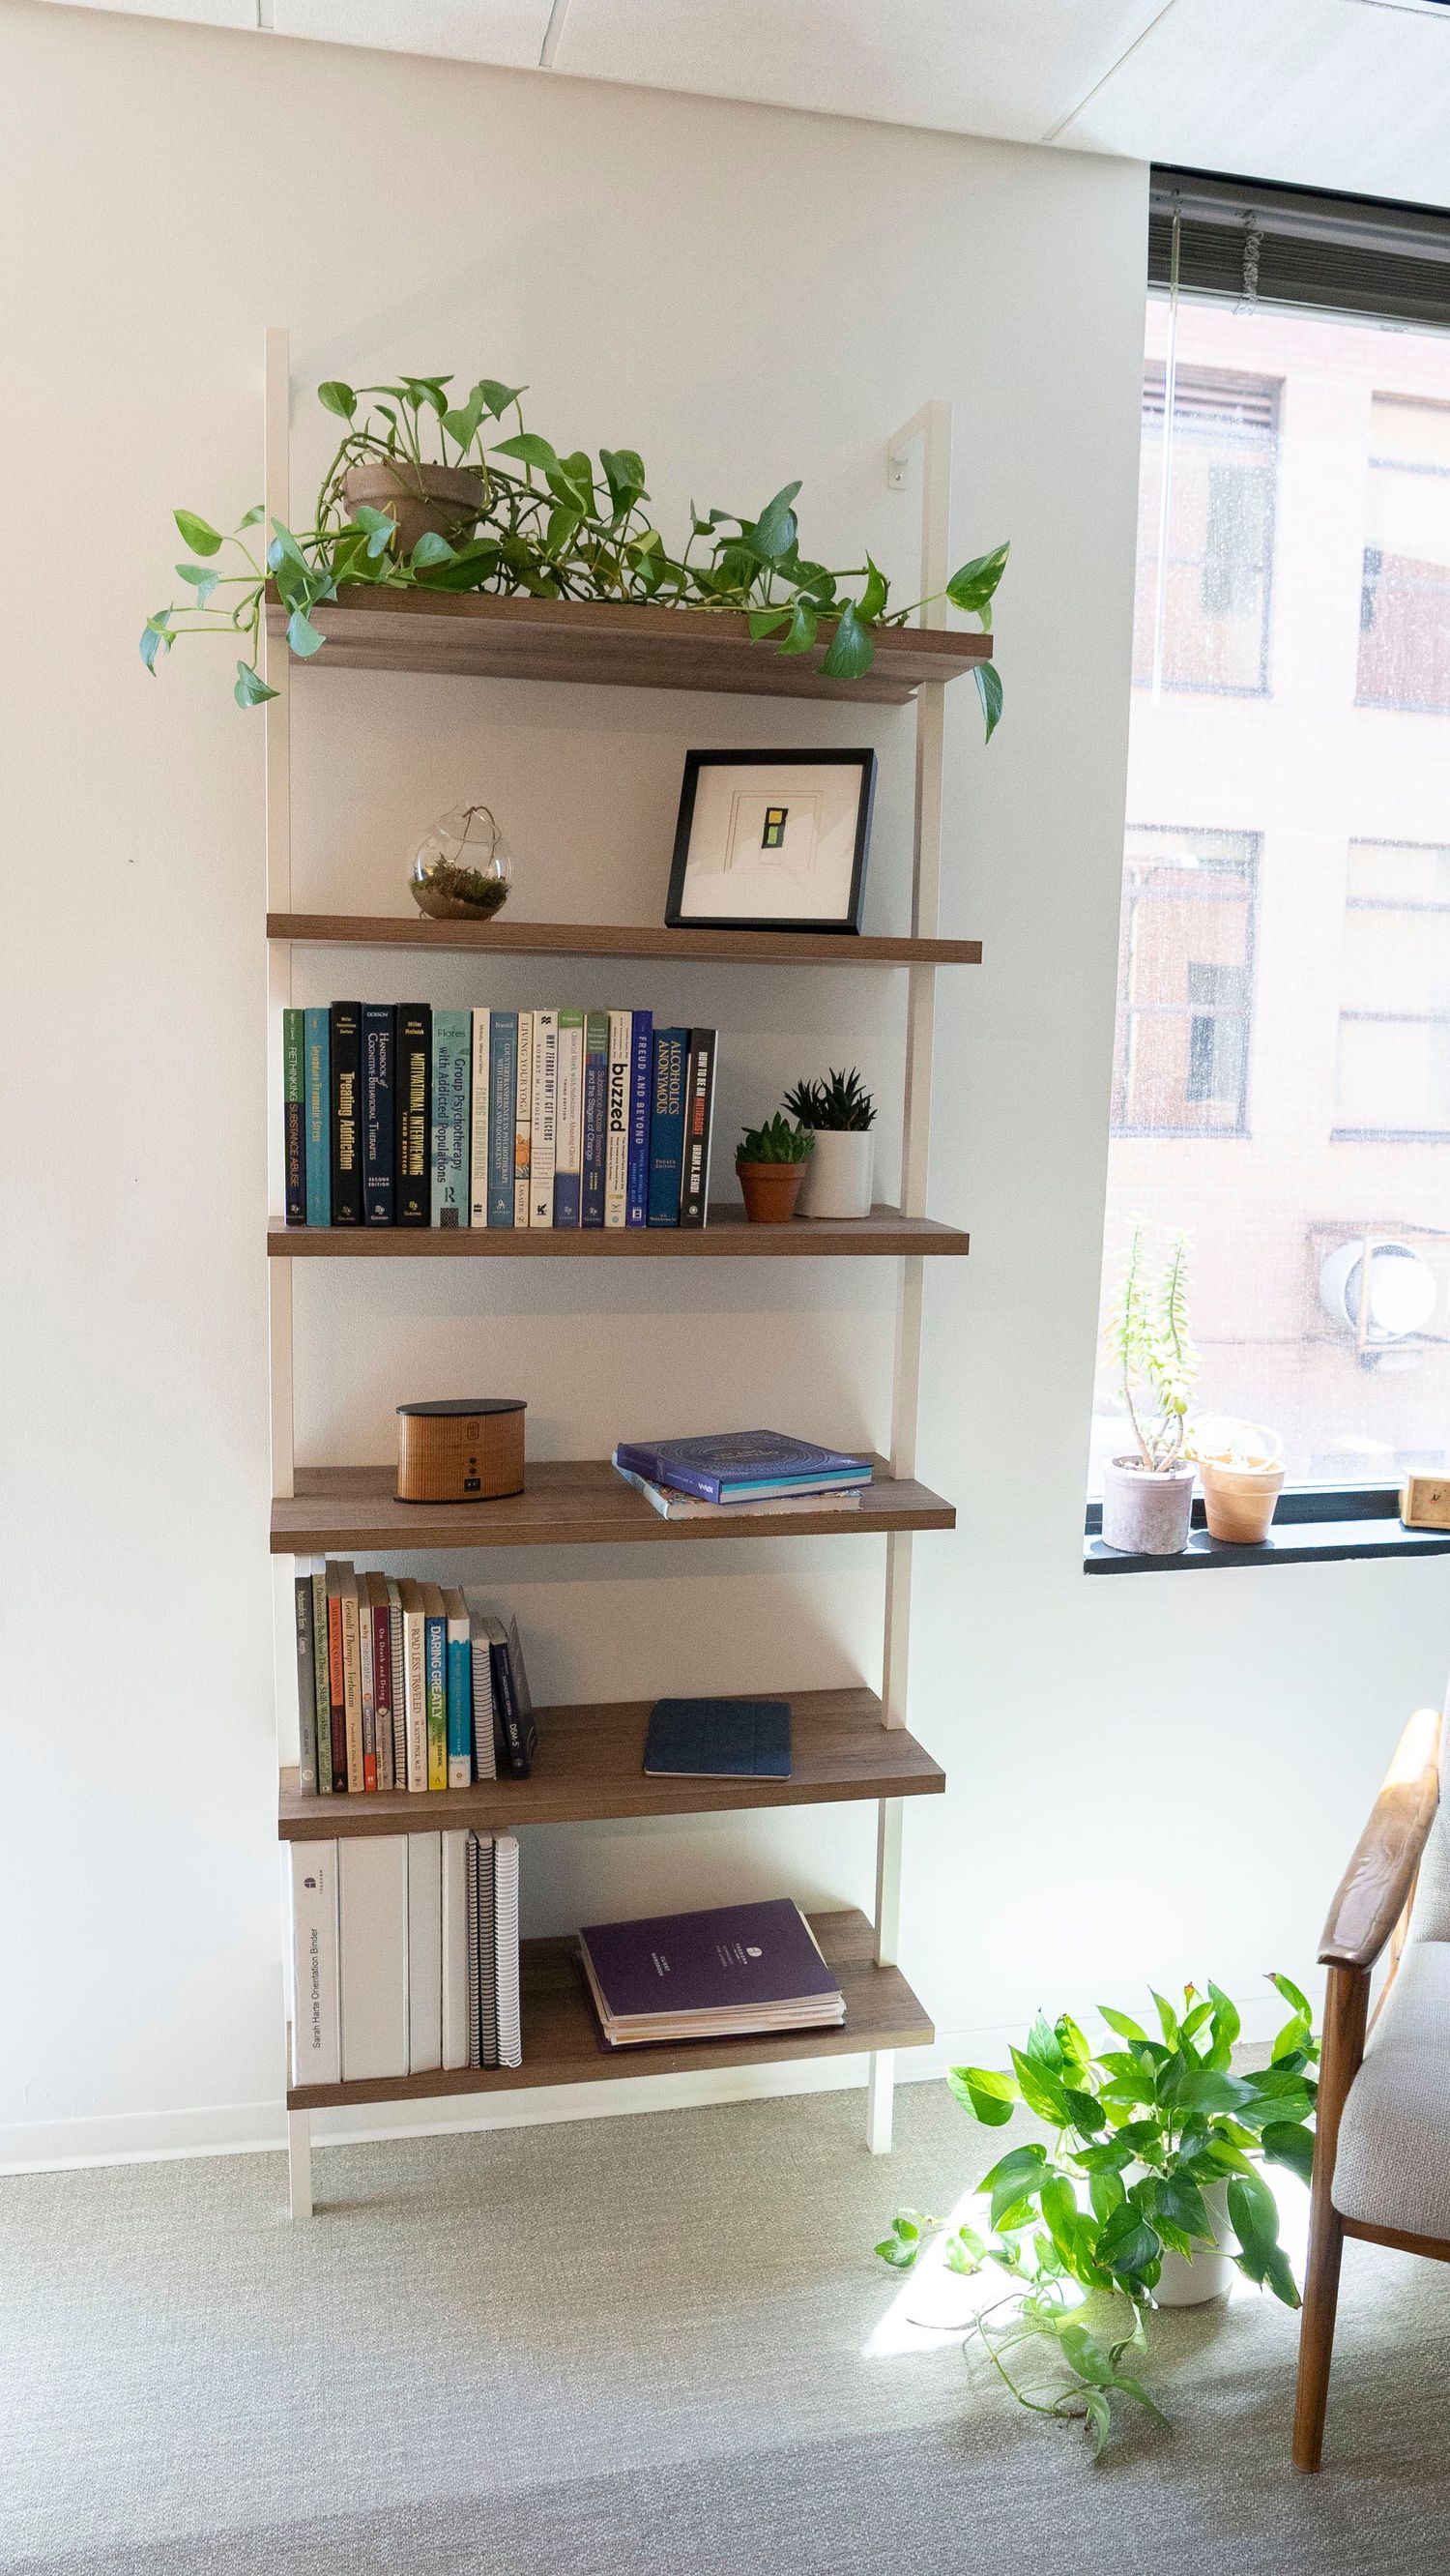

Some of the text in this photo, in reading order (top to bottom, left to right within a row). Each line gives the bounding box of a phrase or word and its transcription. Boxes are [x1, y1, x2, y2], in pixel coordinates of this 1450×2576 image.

[437, 1029, 466, 1038] Flores
[569, 1031, 578, 1054] Clinical
[288, 1046, 299, 1101] RETHINKING
[378, 1032, 390, 1089] HANDBOOK of
[502, 1043, 511, 1123] COUNTERTRANSFERENCE
[518, 1022, 530, 1115] LIVING YOUR YOGA
[588, 1070, 596, 1085] and
[656, 1039, 669, 1115] ANONYMOUS
[669, 1039, 682, 1115] ALCOHOLICS
[368, 1033, 379, 1160] COGNITIVE-BEHAVIORAL THERAPIES
[543, 1035, 555, 1142] WHY ZEBRAS DON'T GET ULCERS
[586, 1098, 595, 1122] Stages
[588, 1086, 596, 1098] the
[610, 1063, 628, 1132] buzzed
[635, 1036, 647, 1145] FREUD AND BEYOND
[693, 1051, 709, 1136] HOW TO BE AN ANTIRACIST
[289, 1103, 299, 1156] SUBSTANCE
[338, 1071, 356, 1170] Treating Addiction
[408, 1053, 425, 1176] MOTIVATIONAL INTERVIEWING
[435, 1046, 450, 1183] with Addicted Populations
[450, 1058, 466, 1171] Group Psychotherapy
[474, 1087, 487, 1181] FACING CODEPENDENCE
[495, 1110, 504, 1125] AND
[594, 1070, 605, 1167] Substance Abuse Treatment
[494, 1125, 503, 1170] ADOLESCENTS
[501, 1132, 509, 1185] PSYCHOTHERAPY
[586, 1132, 594, 1160] Change
[691, 1144, 703, 1165] IBRAM
[290, 1157, 300, 1188] ABUSE
[689, 1173, 700, 1193] KENDI
[315, 1588, 325, 1625] Dialectical
[317, 1625, 326, 1655] Behavior
[344, 1600, 358, 1708] Gestalt Therapy Verbatim
[361, 1624, 371, 1683] why meditate?
[378, 1627, 386, 1639] On
[378, 1642, 387, 1662] Death
[411, 1628, 420, 1650] ROAD
[430, 1625, 442, 1668] DARING
[317, 1657, 327, 1684] Therapy
[412, 1652, 420, 1671] LESS
[378, 1680, 387, 1702] Dying
[412, 1674, 421, 1714] TRAVELED
[431, 1670, 443, 1719] GREATLY
[508, 1723, 519, 1747] DSM-5
[309, 1927, 321, 2049] Sarah Harte Orientation Binder
